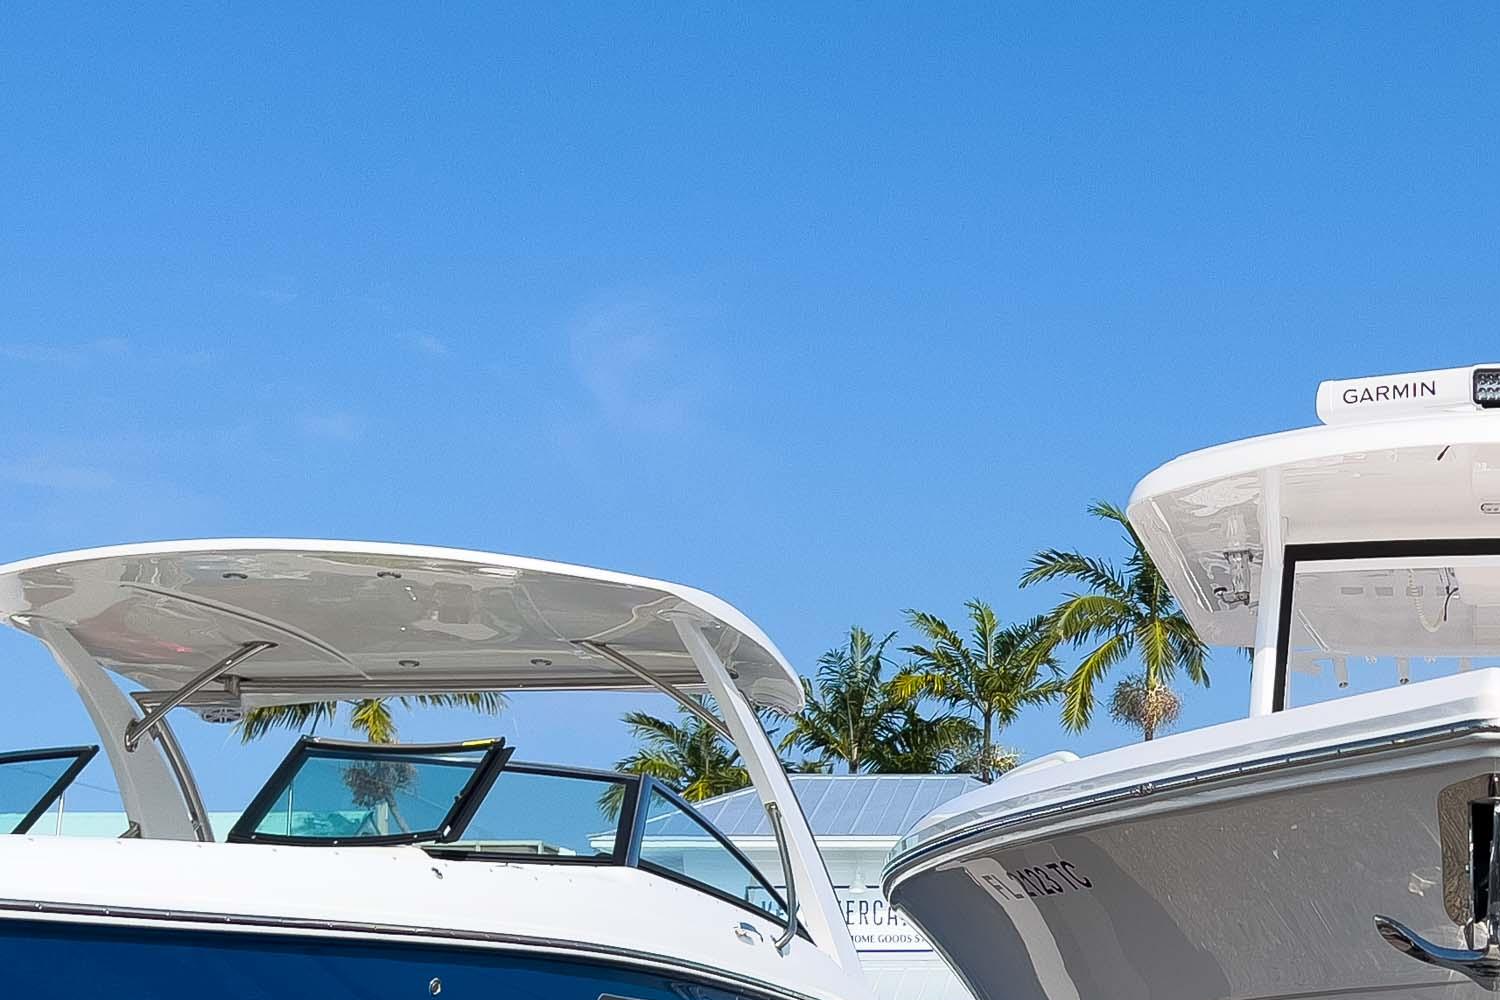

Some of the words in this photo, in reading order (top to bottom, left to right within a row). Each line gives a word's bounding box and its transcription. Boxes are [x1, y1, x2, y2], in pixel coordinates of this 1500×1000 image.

[1343, 381, 1436, 404] GARMIN
[981, 873, 1024, 900] FL
[1006, 866, 1063, 896] 2123
[1045, 860, 1093, 890] TC
[840, 900, 906, 926] ERCA
[878, 934, 912, 943] GOODS
